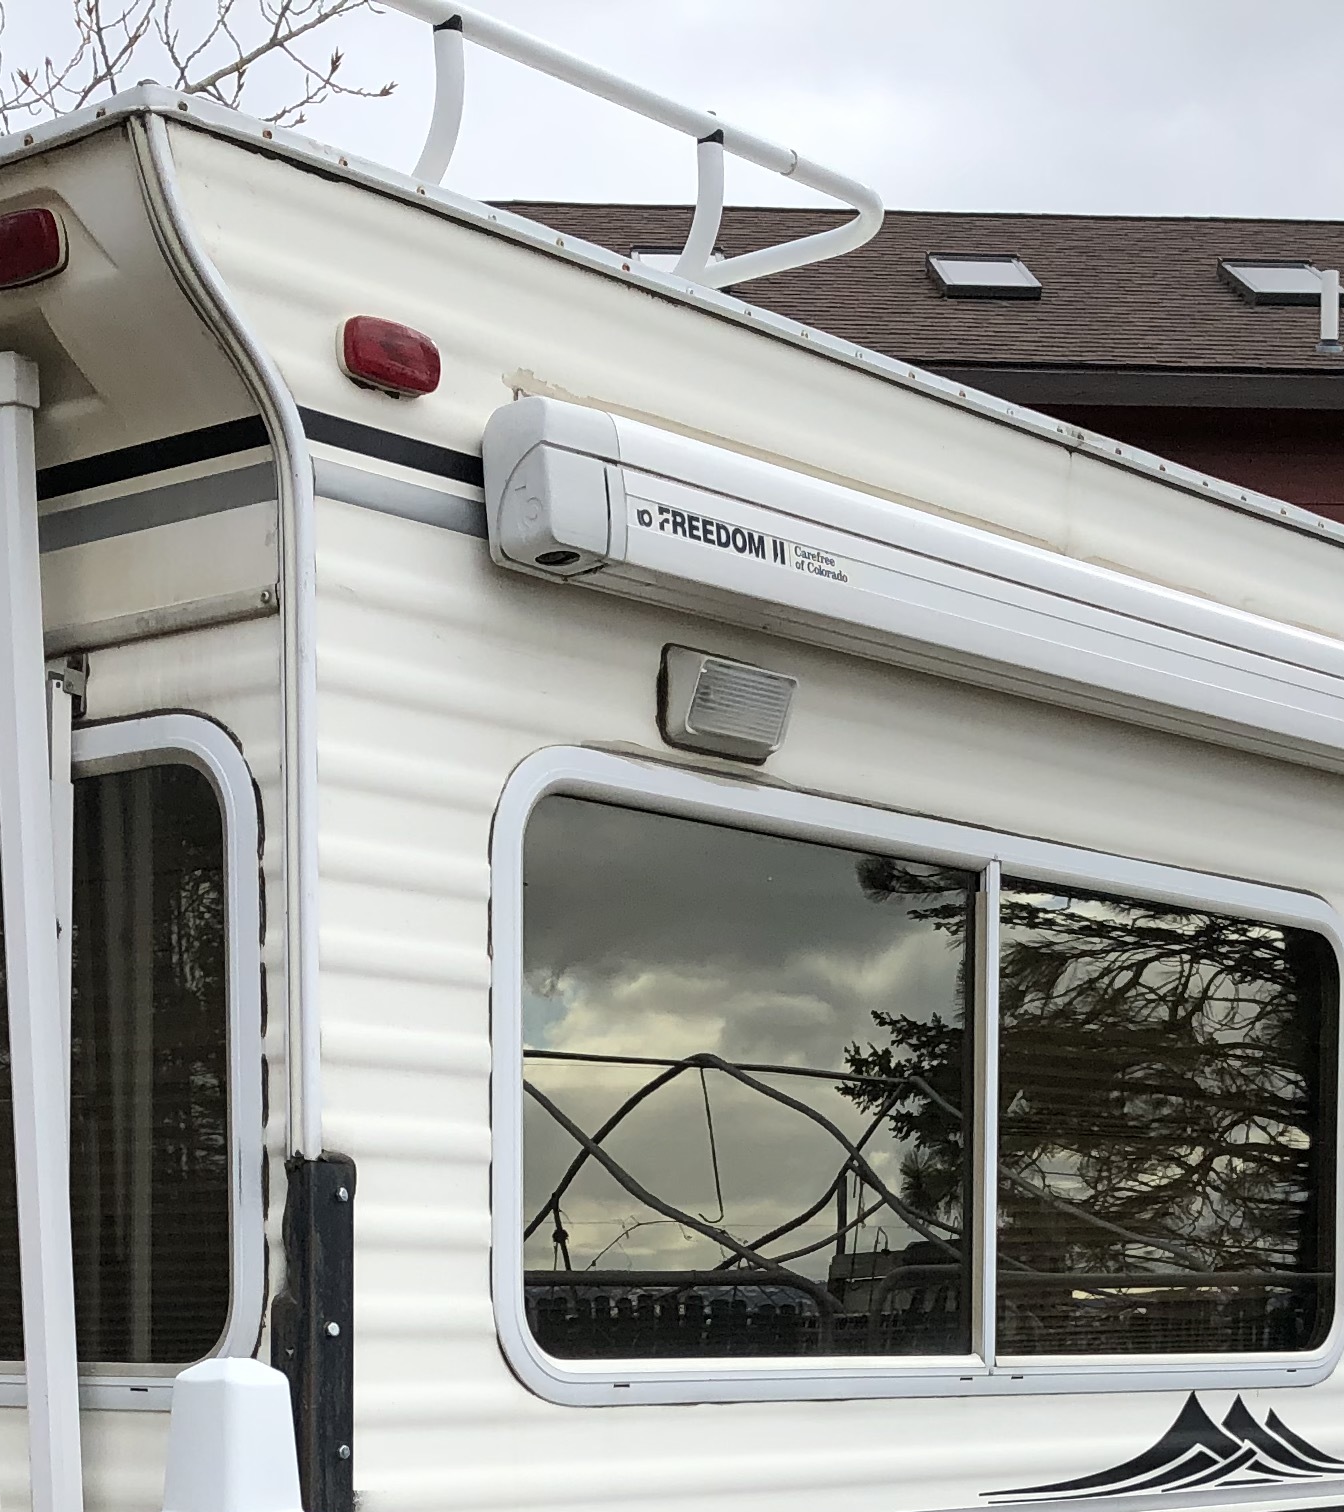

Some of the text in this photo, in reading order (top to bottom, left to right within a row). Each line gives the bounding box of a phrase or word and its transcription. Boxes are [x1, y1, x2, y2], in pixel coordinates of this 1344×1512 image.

[658, 506, 786, 565] FREEDOM II
[794, 545, 836, 567] Carefree
[795, 561, 849, 584] of Colorado
